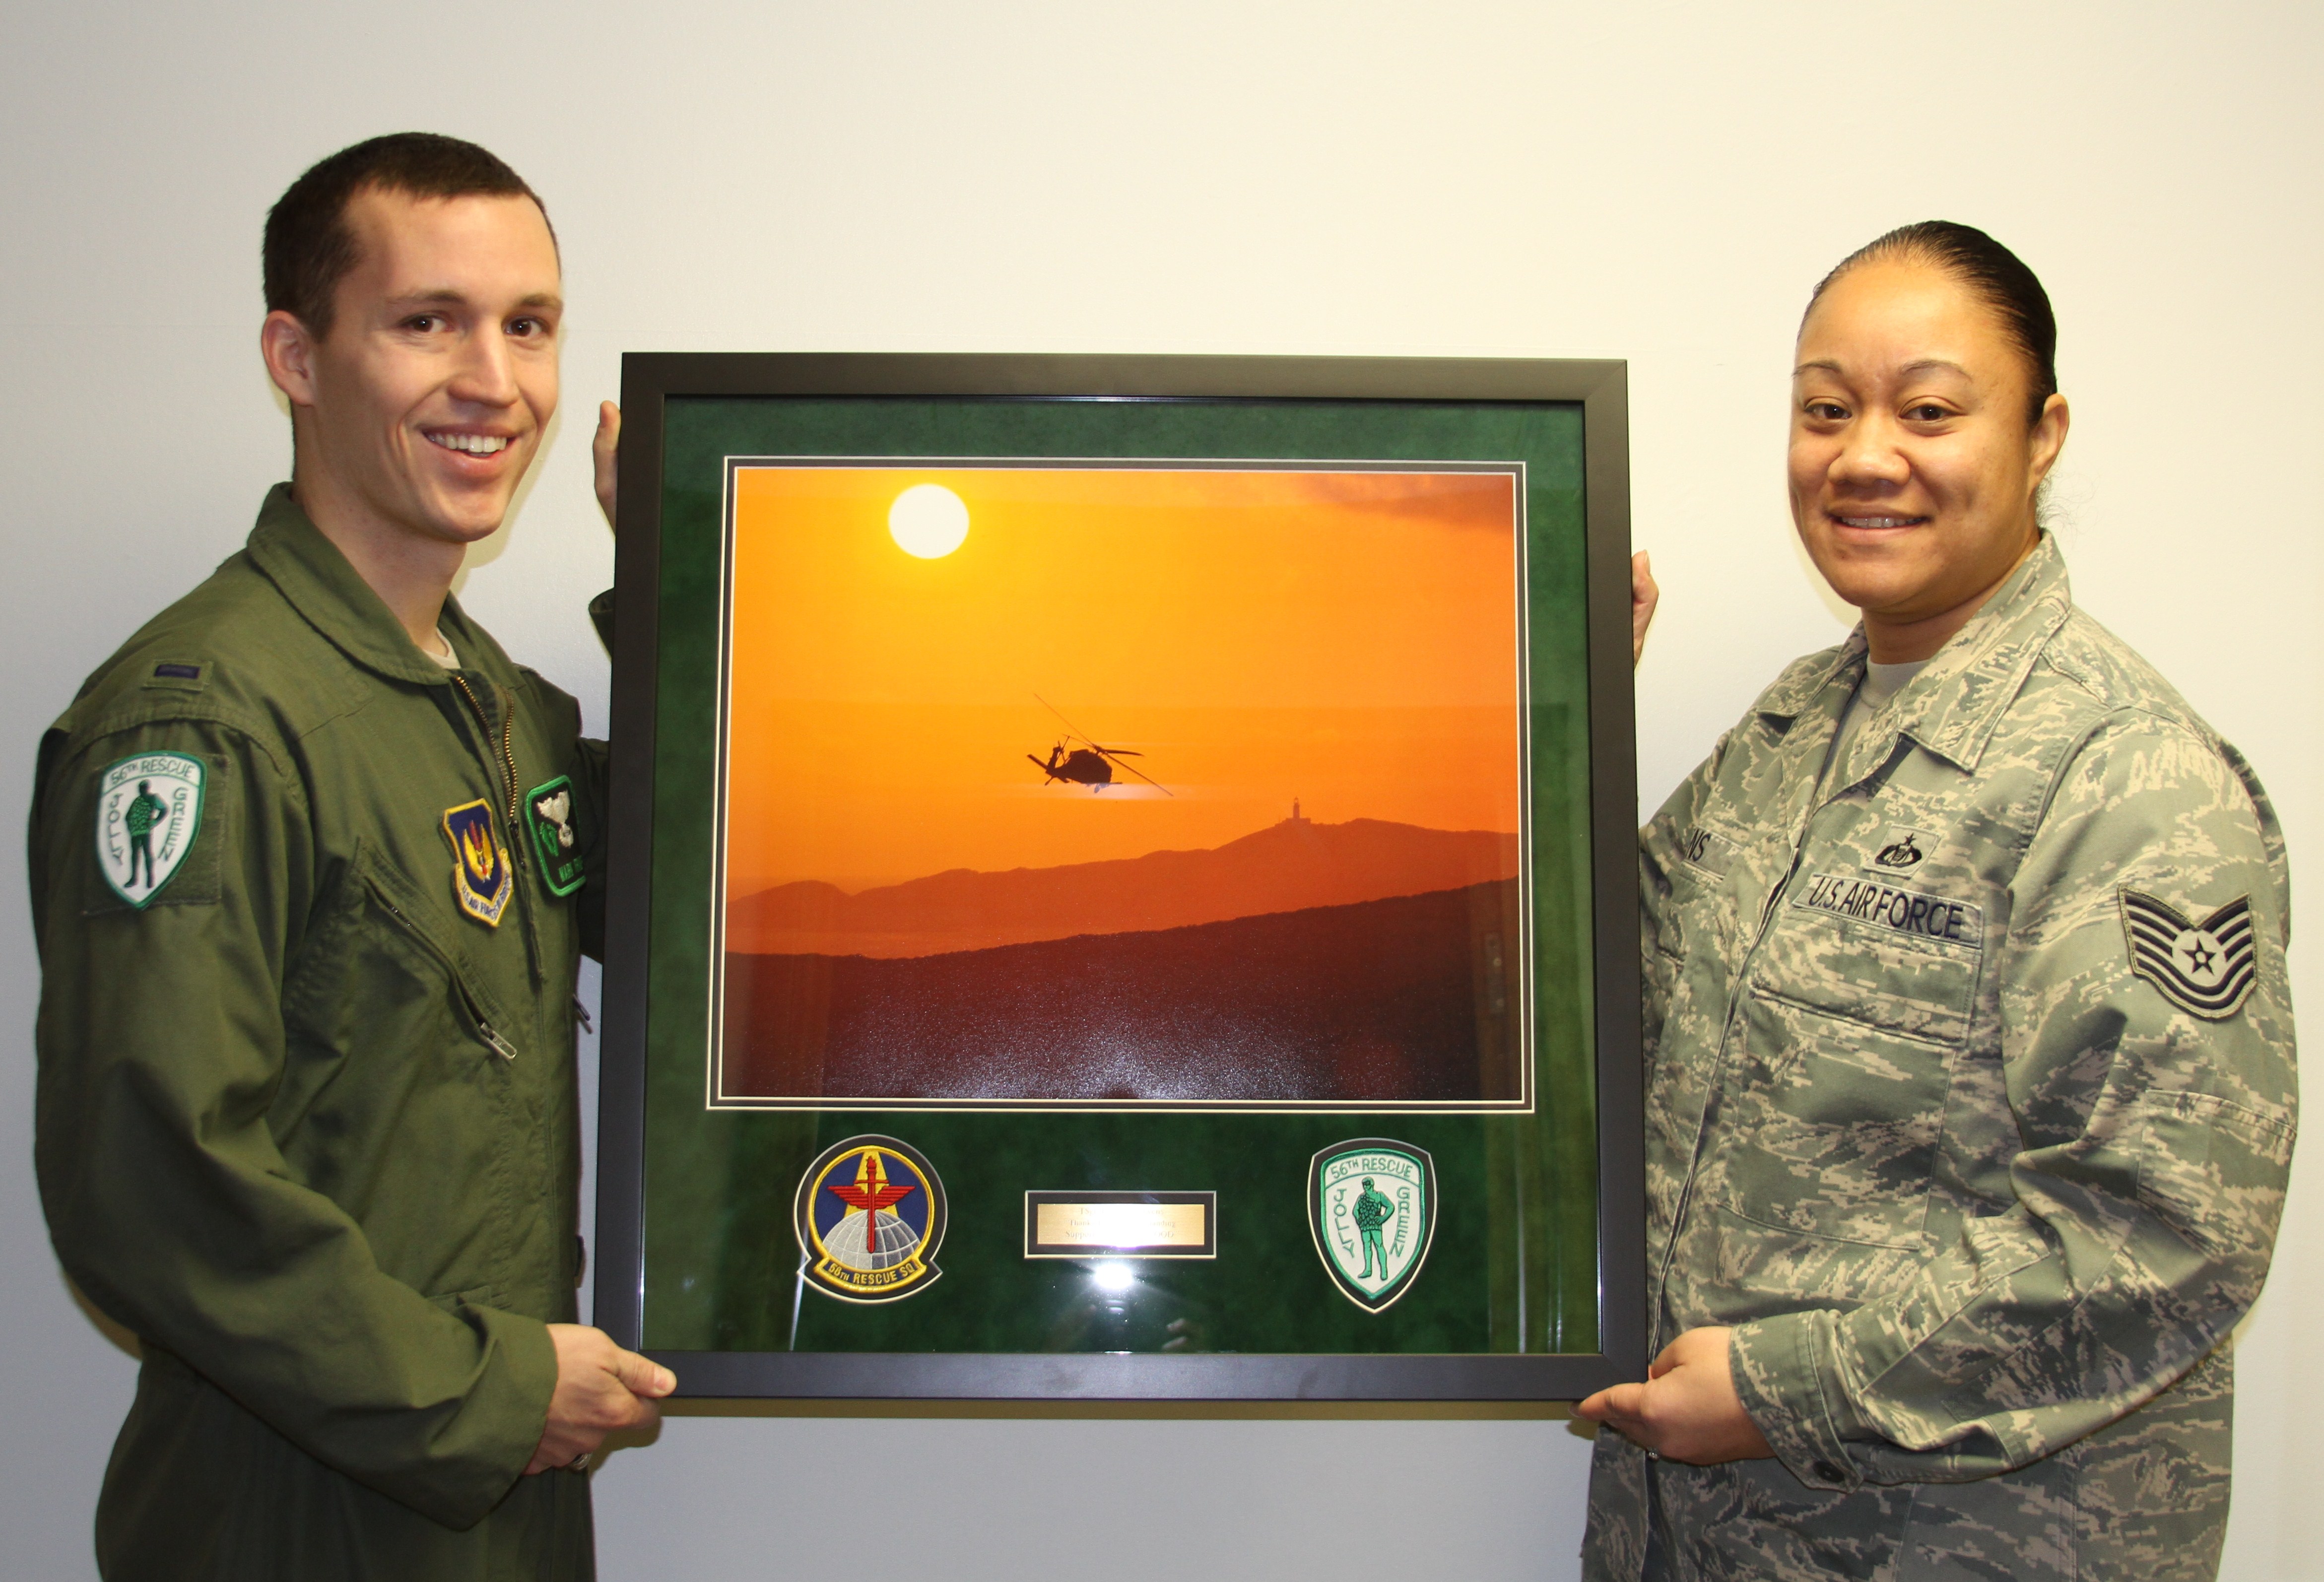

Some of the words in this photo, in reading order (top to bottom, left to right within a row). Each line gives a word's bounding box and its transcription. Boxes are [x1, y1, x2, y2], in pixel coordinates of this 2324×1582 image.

[141, 758, 196, 778] RESCUE
[109, 793, 123, 865] JOLLY
[158, 787, 189, 861] GREEN
[1838, 882, 1877, 918] AIR
[1872, 889, 1964, 939] FORCE
[1330, 1158, 1359, 1179] 56TH
[1362, 1157, 1413, 1178] RESCUE
[1333, 1188, 1355, 1258] JOLLY
[1390, 1186, 1411, 1257] GREEN
[853, 1270, 898, 1285] RESCUE
[899, 1262, 915, 1277] SQ
